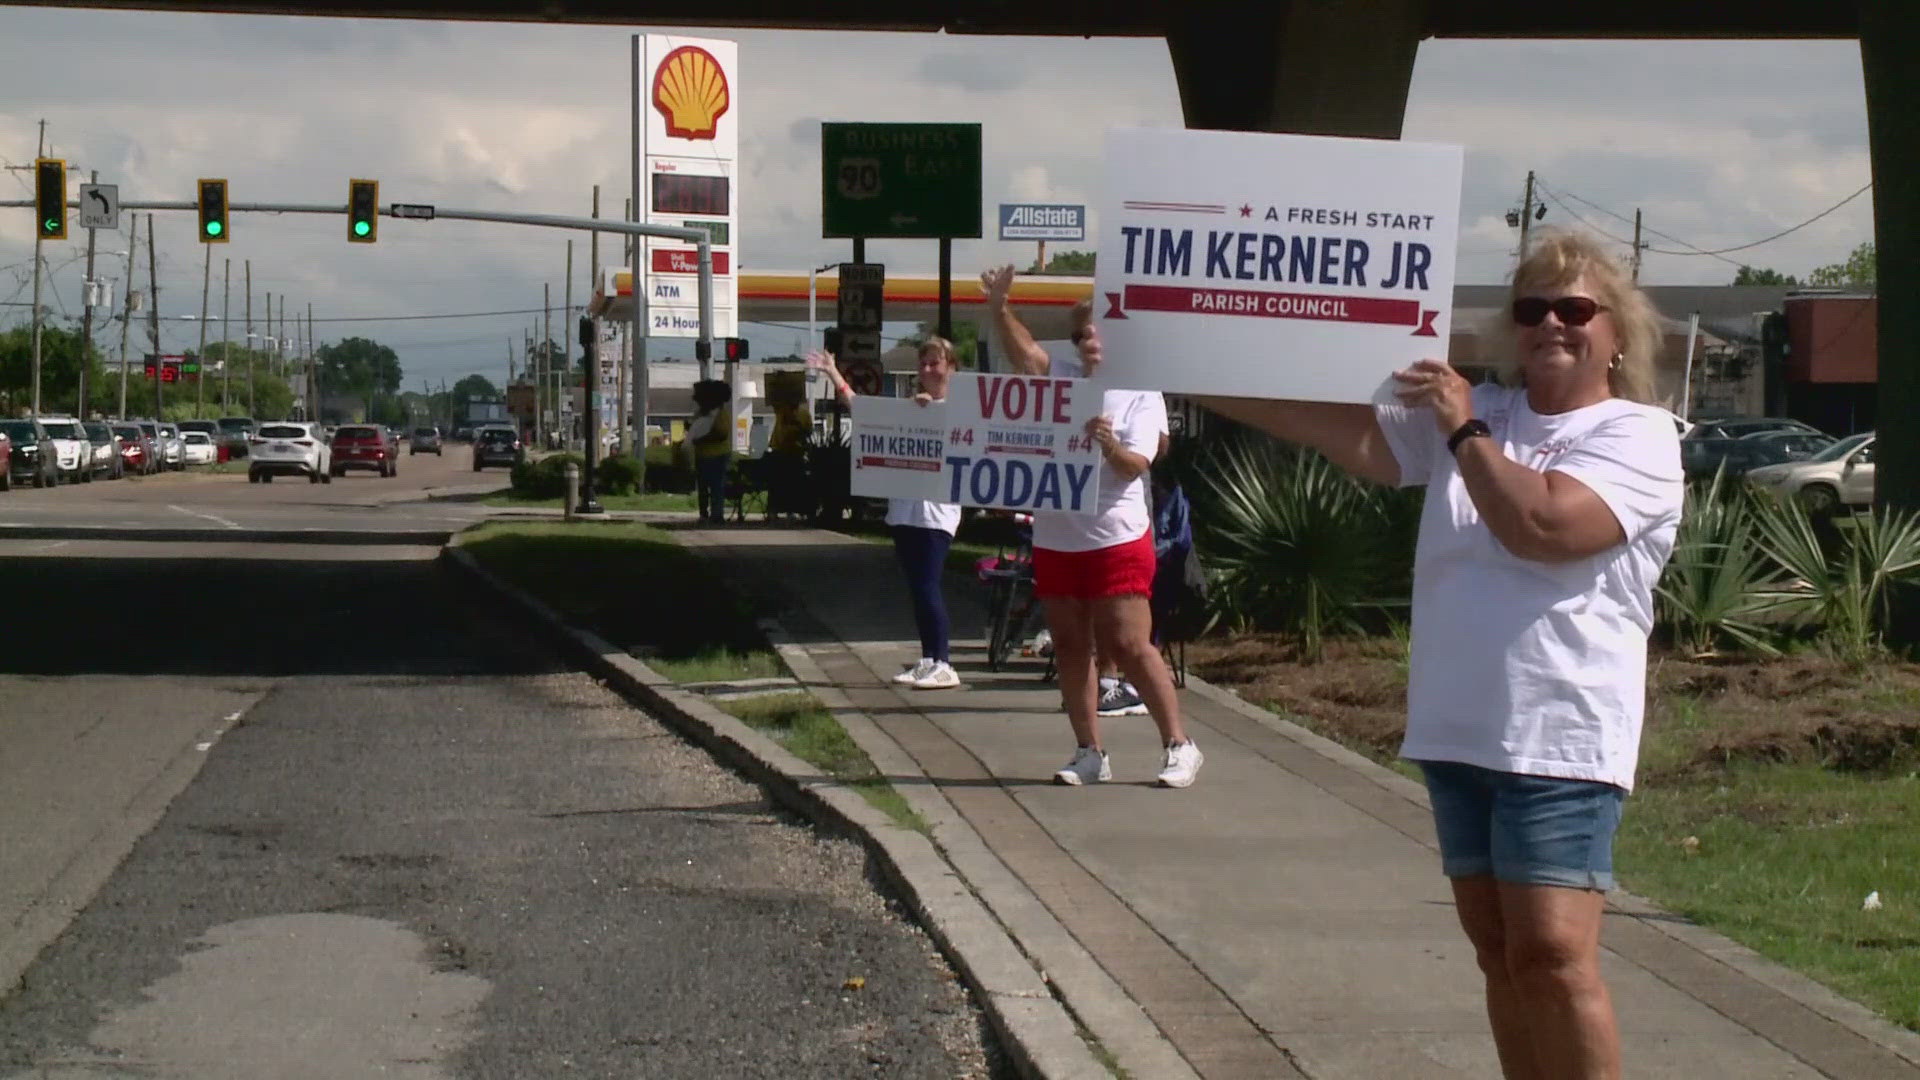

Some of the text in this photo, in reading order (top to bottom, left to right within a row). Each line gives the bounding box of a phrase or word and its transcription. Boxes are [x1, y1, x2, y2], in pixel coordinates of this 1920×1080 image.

[846, 130, 959, 151] BUSINESS
[842, 165, 877, 191] 90
[85, 215, 112, 225] ONLY
[1008, 206, 1077, 226] Allstate
[1264, 207, 1434, 230] A FRESH START
[1121, 227, 1431, 290] TIM KERNER JR
[655, 285, 680, 297] ATM
[1192, 292, 1349, 318] PARISH COUNCIL
[655, 316, 668, 328] 24
[977, 375, 1073, 424] VOTE
[860, 433, 943, 459] TIM KERNER
[950, 427, 974, 446] #4
[988, 430, 1054, 447] TIM KERNER JR
[1067, 434, 1092, 453] #4
[946, 456, 1093, 511] TODAY
